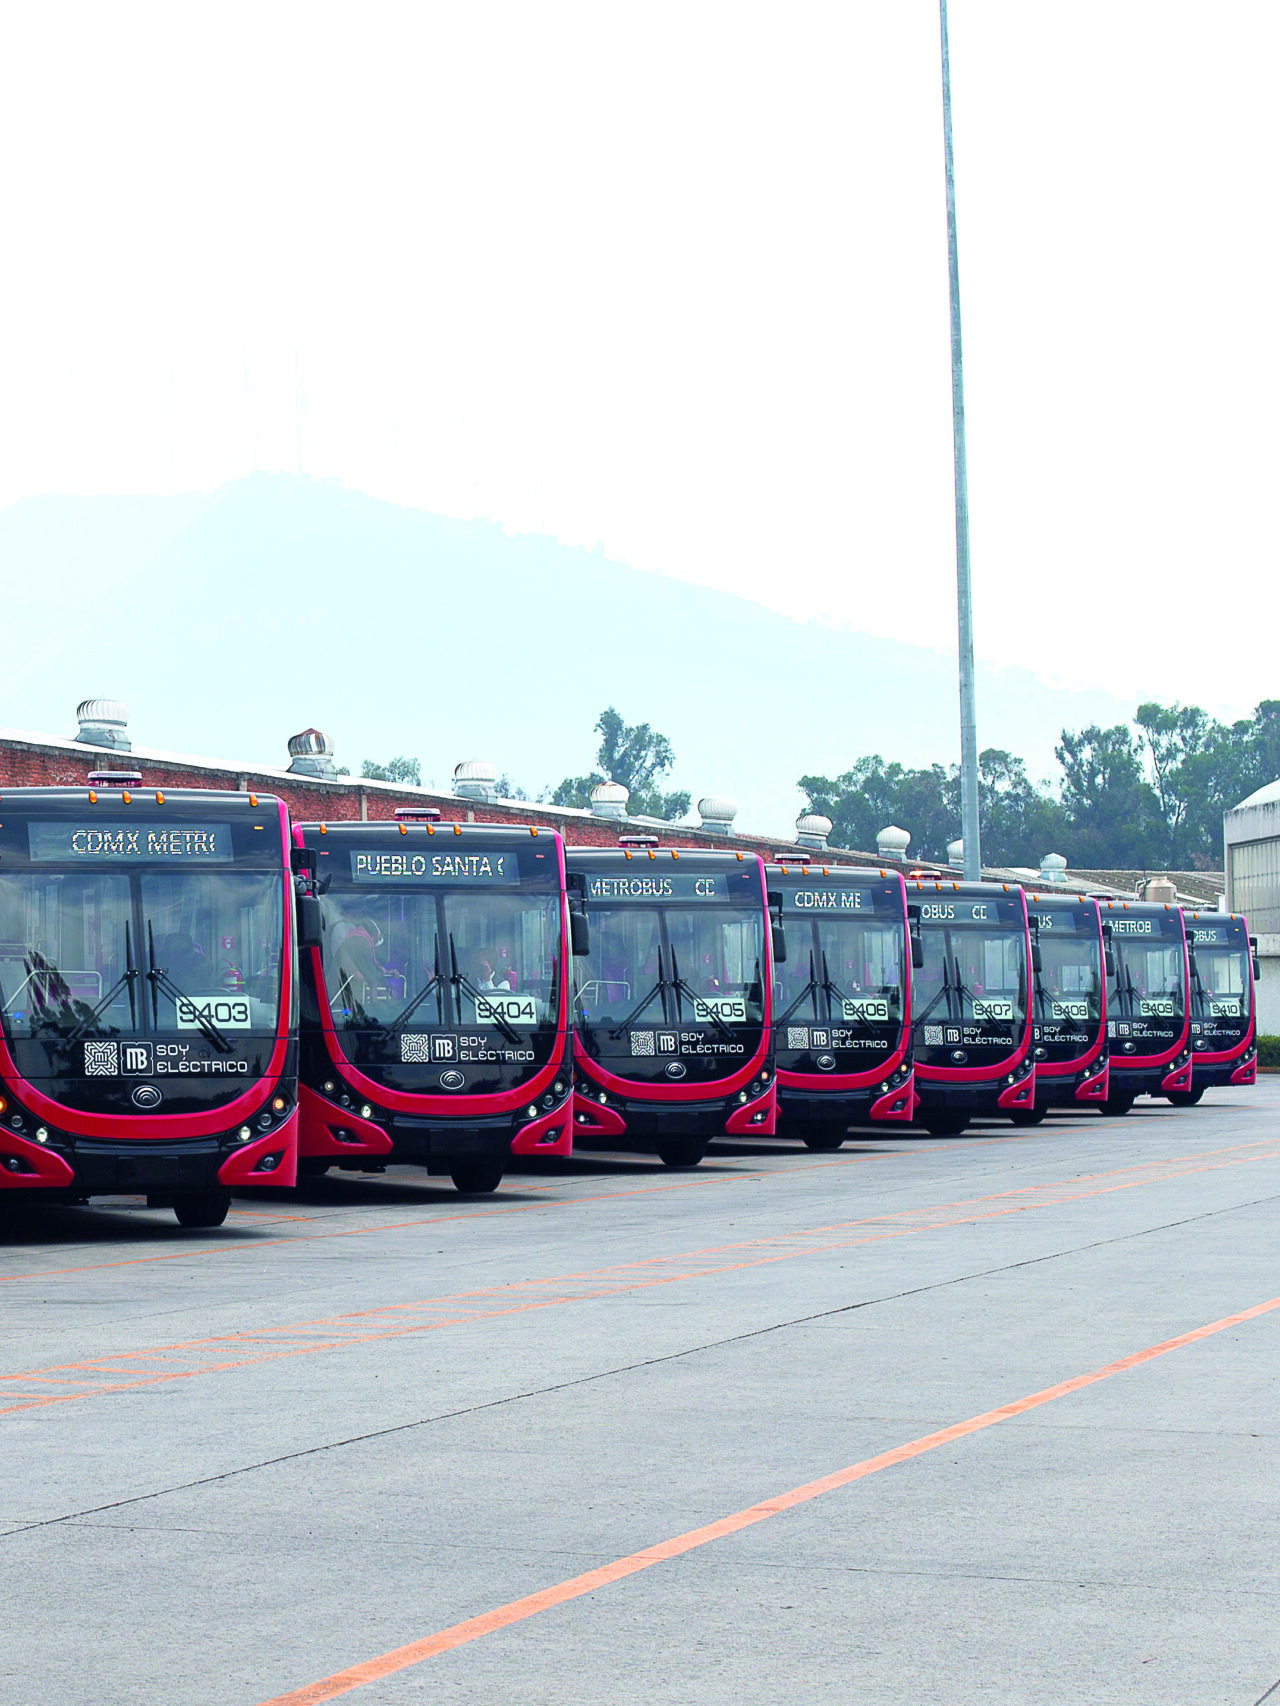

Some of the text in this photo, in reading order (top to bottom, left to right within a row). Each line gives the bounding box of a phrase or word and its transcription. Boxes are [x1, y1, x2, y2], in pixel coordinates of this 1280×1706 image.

[72, 830, 141, 854] CDMX
[356, 855, 426, 876] PUEBLO
[432, 856, 492, 876] SANTA
[794, 892, 861, 908] CDMX ME
[922, 904, 955, 919] OBUS
[179, 1002, 248, 1023] 9403
[477, 1002, 534, 1019] 9404
[696, 1002, 744, 1018] 9405
[844, 1003, 886, 1016] 9406
[974, 1004, 1012, 1016] 9407
[1054, 1004, 1088, 1016] 9408
[1141, 1003, 1173, 1014] 9409
[1212, 1004, 1238, 1014] 9410
[680, 1032, 704, 1042] SOY
[831, 1029, 853, 1038] SOY
[963, 1027, 982, 1035] SOY
[436, 1039, 453, 1058] MB
[460, 1036, 488, 1047] SOY
[660, 1035, 676, 1051] MB
[681, 1042, 744, 1054] ELÉCTRICO
[832, 1037, 888, 1048] ELÉCTRICO
[156, 1044, 190, 1056] SOY
[460, 1046, 535, 1061] ELÉCTRICO
[126, 1048, 148, 1070] MB
[156, 1057, 248, 1073] ELÉCTRICO
